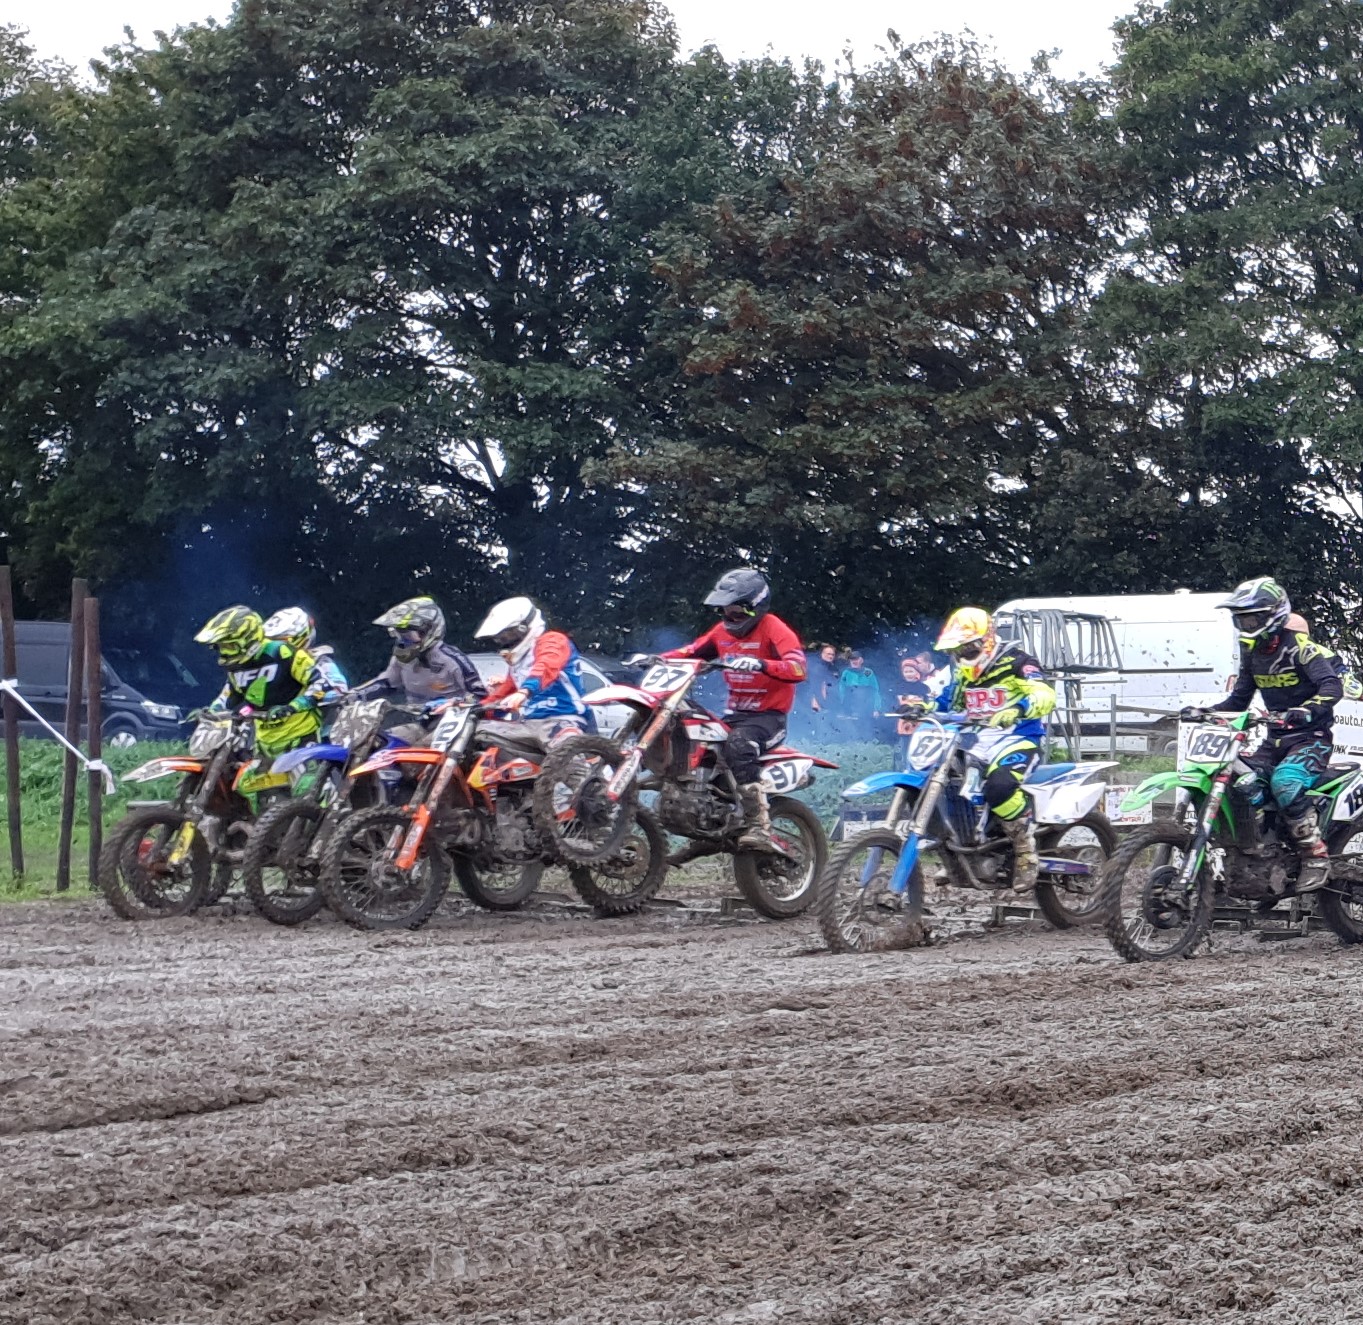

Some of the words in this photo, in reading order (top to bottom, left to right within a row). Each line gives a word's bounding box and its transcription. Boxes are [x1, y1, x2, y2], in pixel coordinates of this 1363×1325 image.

[646, 667, 688, 690] 97
[911, 735, 945, 758] 67
[1190, 732, 1231, 758] 189
[768, 762, 798, 790] 97
